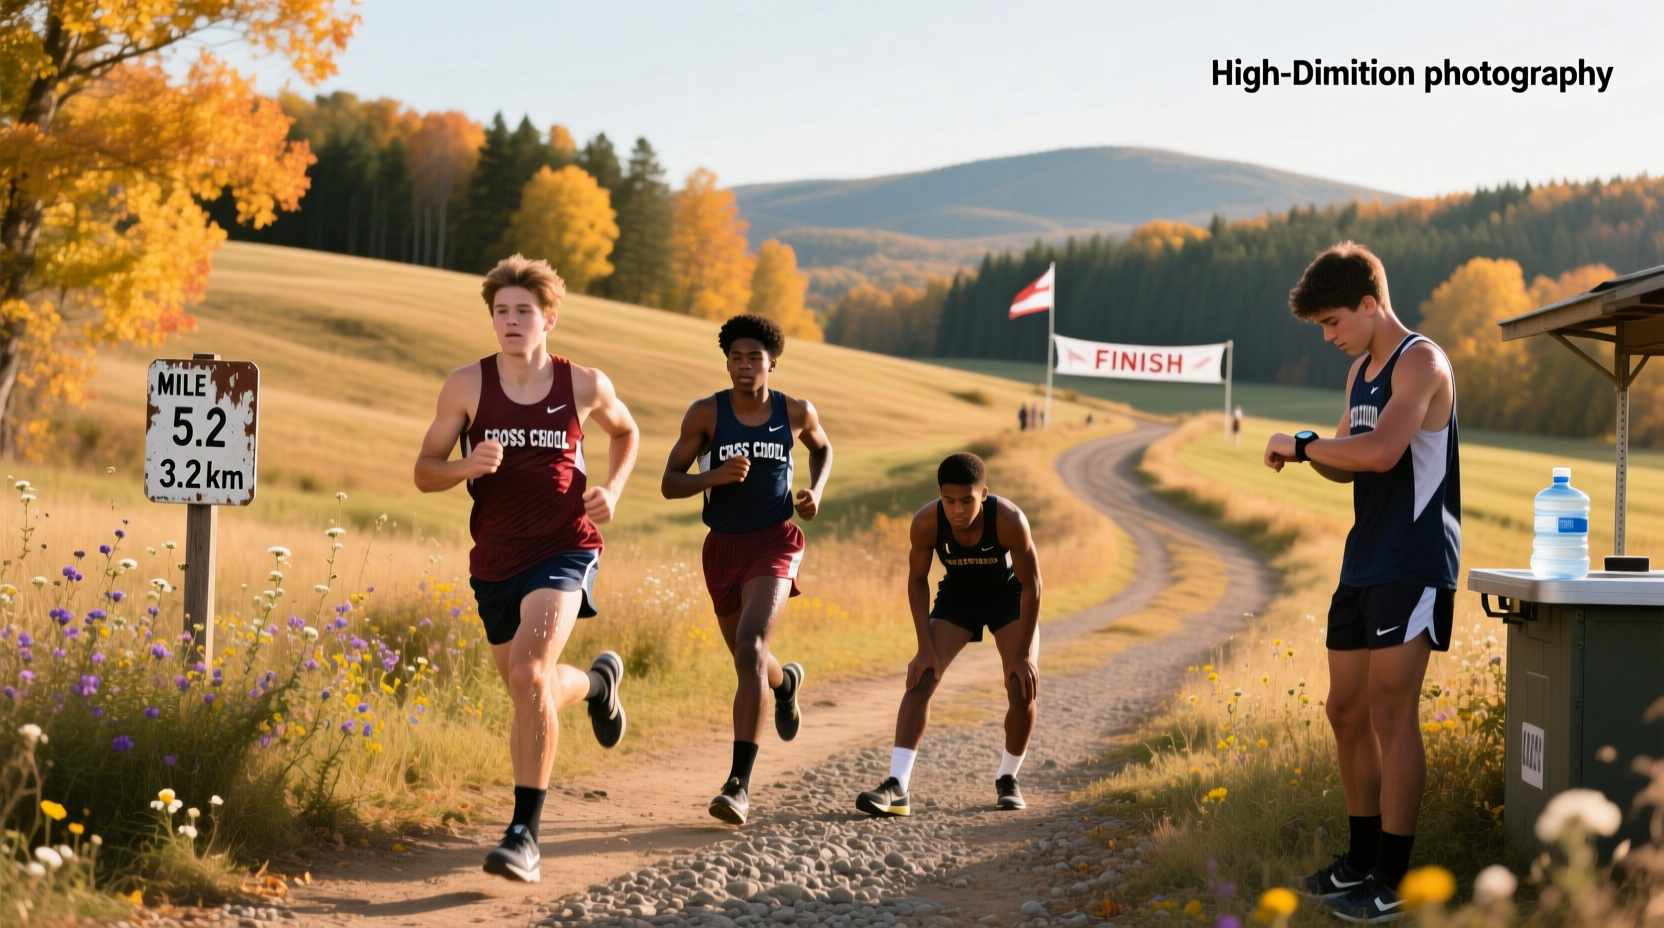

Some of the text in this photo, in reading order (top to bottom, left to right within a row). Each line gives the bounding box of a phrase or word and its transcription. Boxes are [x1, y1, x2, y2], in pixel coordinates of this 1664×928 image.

[1095, 349, 1183, 374] FINISH
[158, 371, 207, 397] MILE
[172, 406, 227, 448] 5.2
[159, 458, 244, 490] 3.2 km
